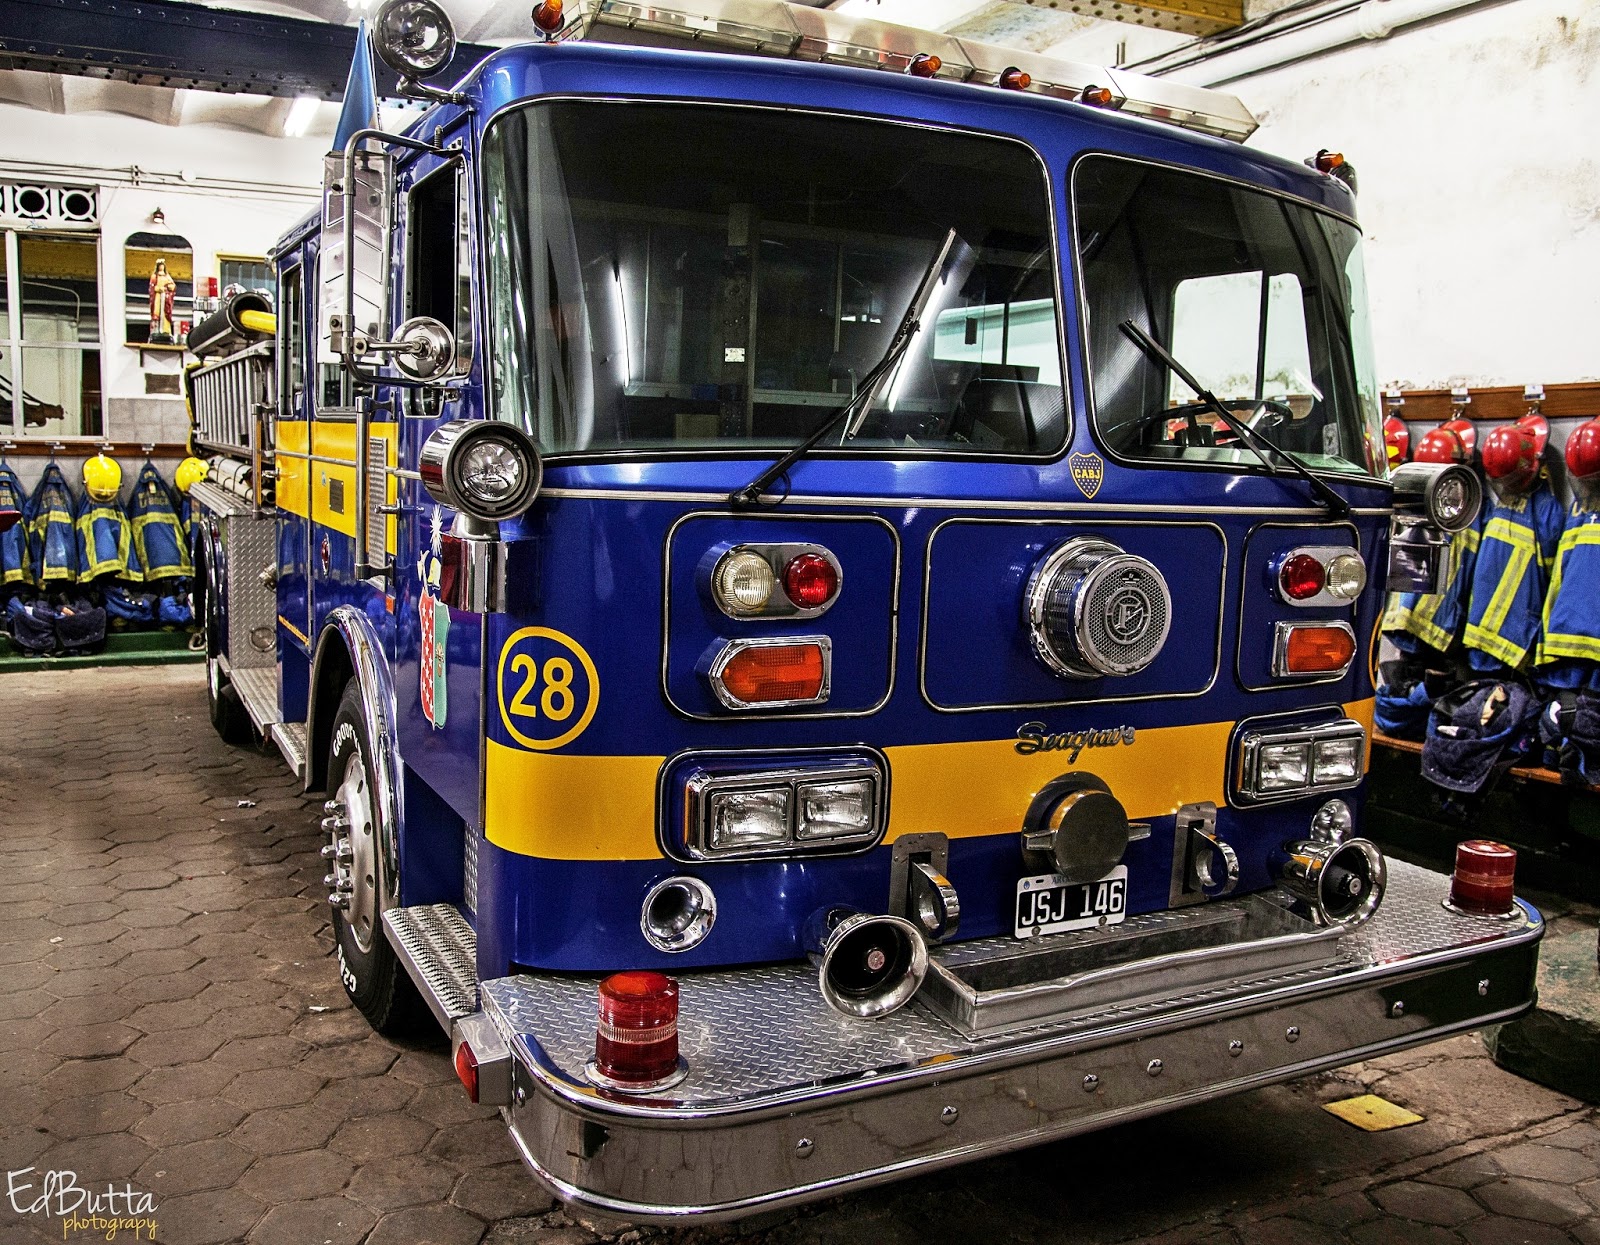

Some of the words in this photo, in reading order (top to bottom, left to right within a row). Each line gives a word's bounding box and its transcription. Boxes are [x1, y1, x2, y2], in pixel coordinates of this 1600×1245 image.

[1074, 468, 1101, 479] CABJ
[509, 653, 575, 721] 28
[1014, 720, 1136, 765] Seagrave
[1021, 888, 1066, 926] JSJ
[1079, 880, 1123, 917] 146
